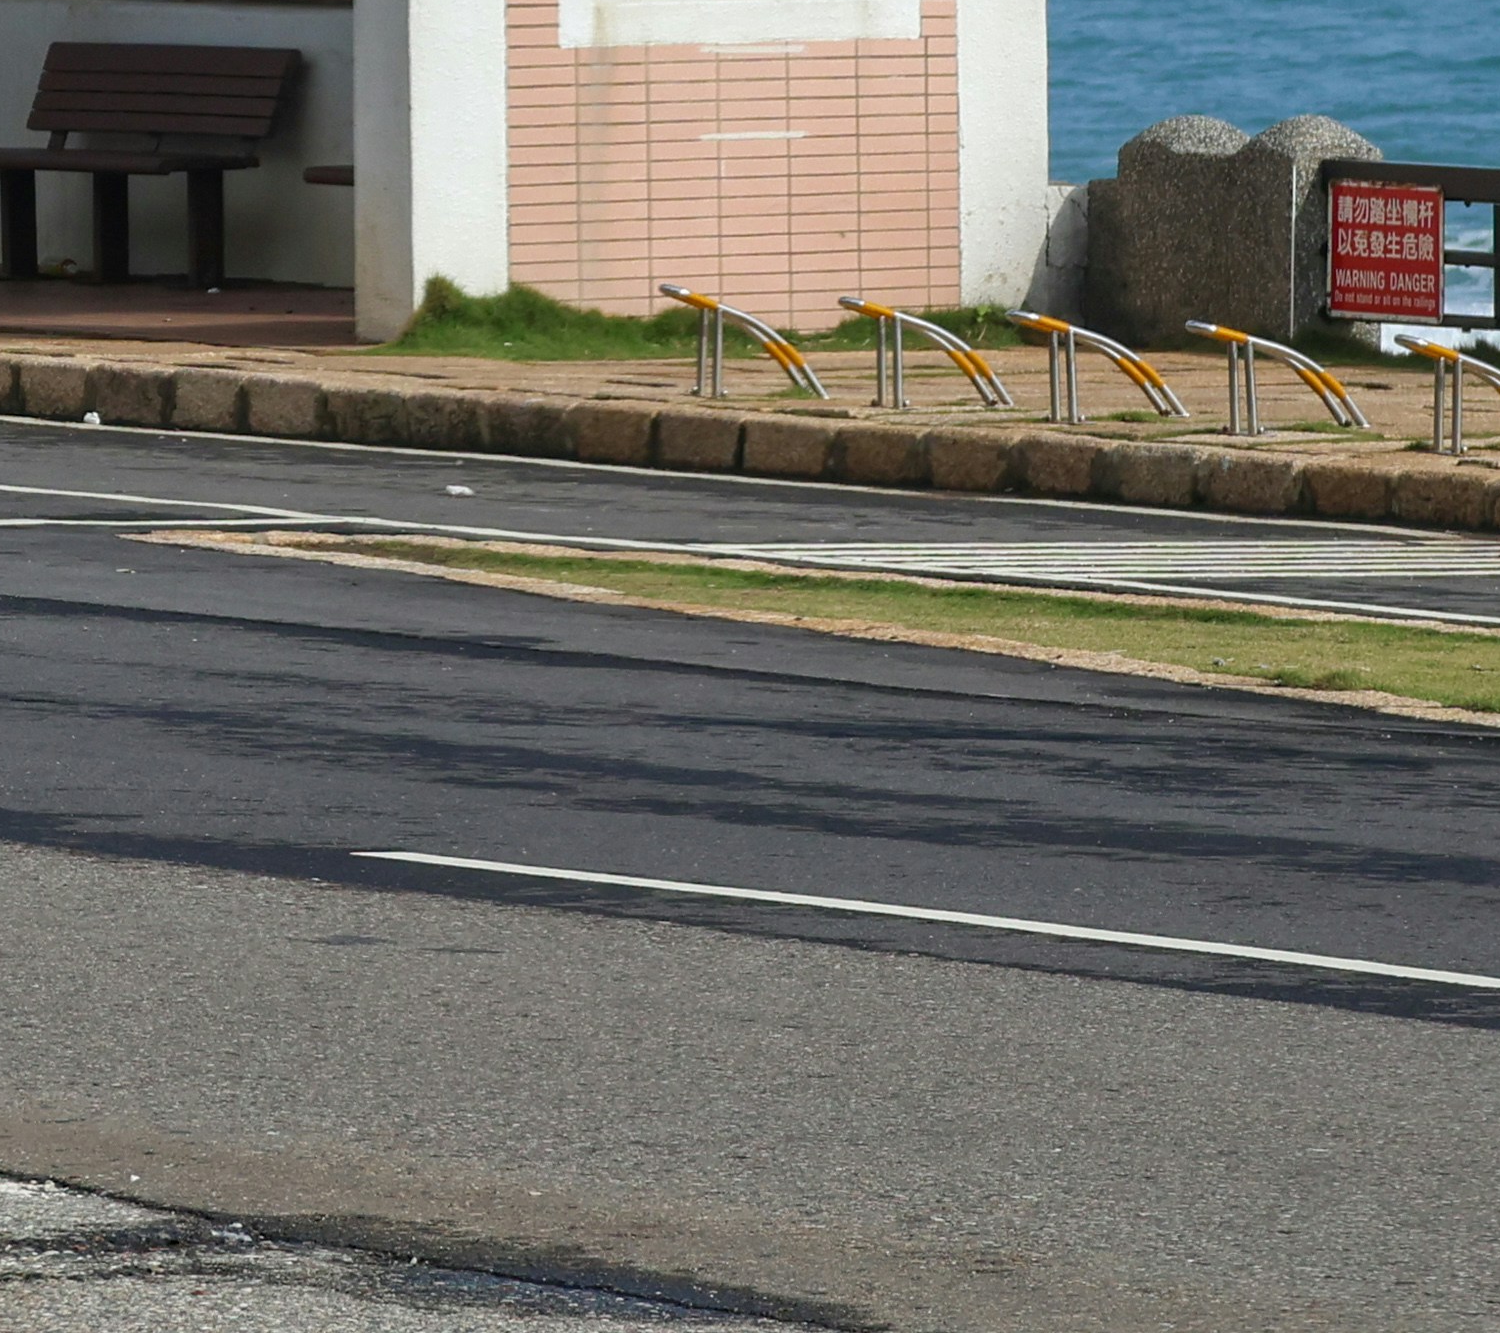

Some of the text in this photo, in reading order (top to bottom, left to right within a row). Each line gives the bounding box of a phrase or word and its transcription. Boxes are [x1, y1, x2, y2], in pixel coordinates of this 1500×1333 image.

[1337, 195, 1435, 229] 請勿踏坐欄杆
[1336, 227, 1435, 262] 以免發生危險
[1335, 268, 1436, 294] WARNING DANGER
[1334, 290, 1343, 303] Do
[1344, 291, 1355, 303] not
[1356, 292, 1374, 305] stand
[1374, 295, 1381, 305] or
[1402, 295, 1412, 308] the
